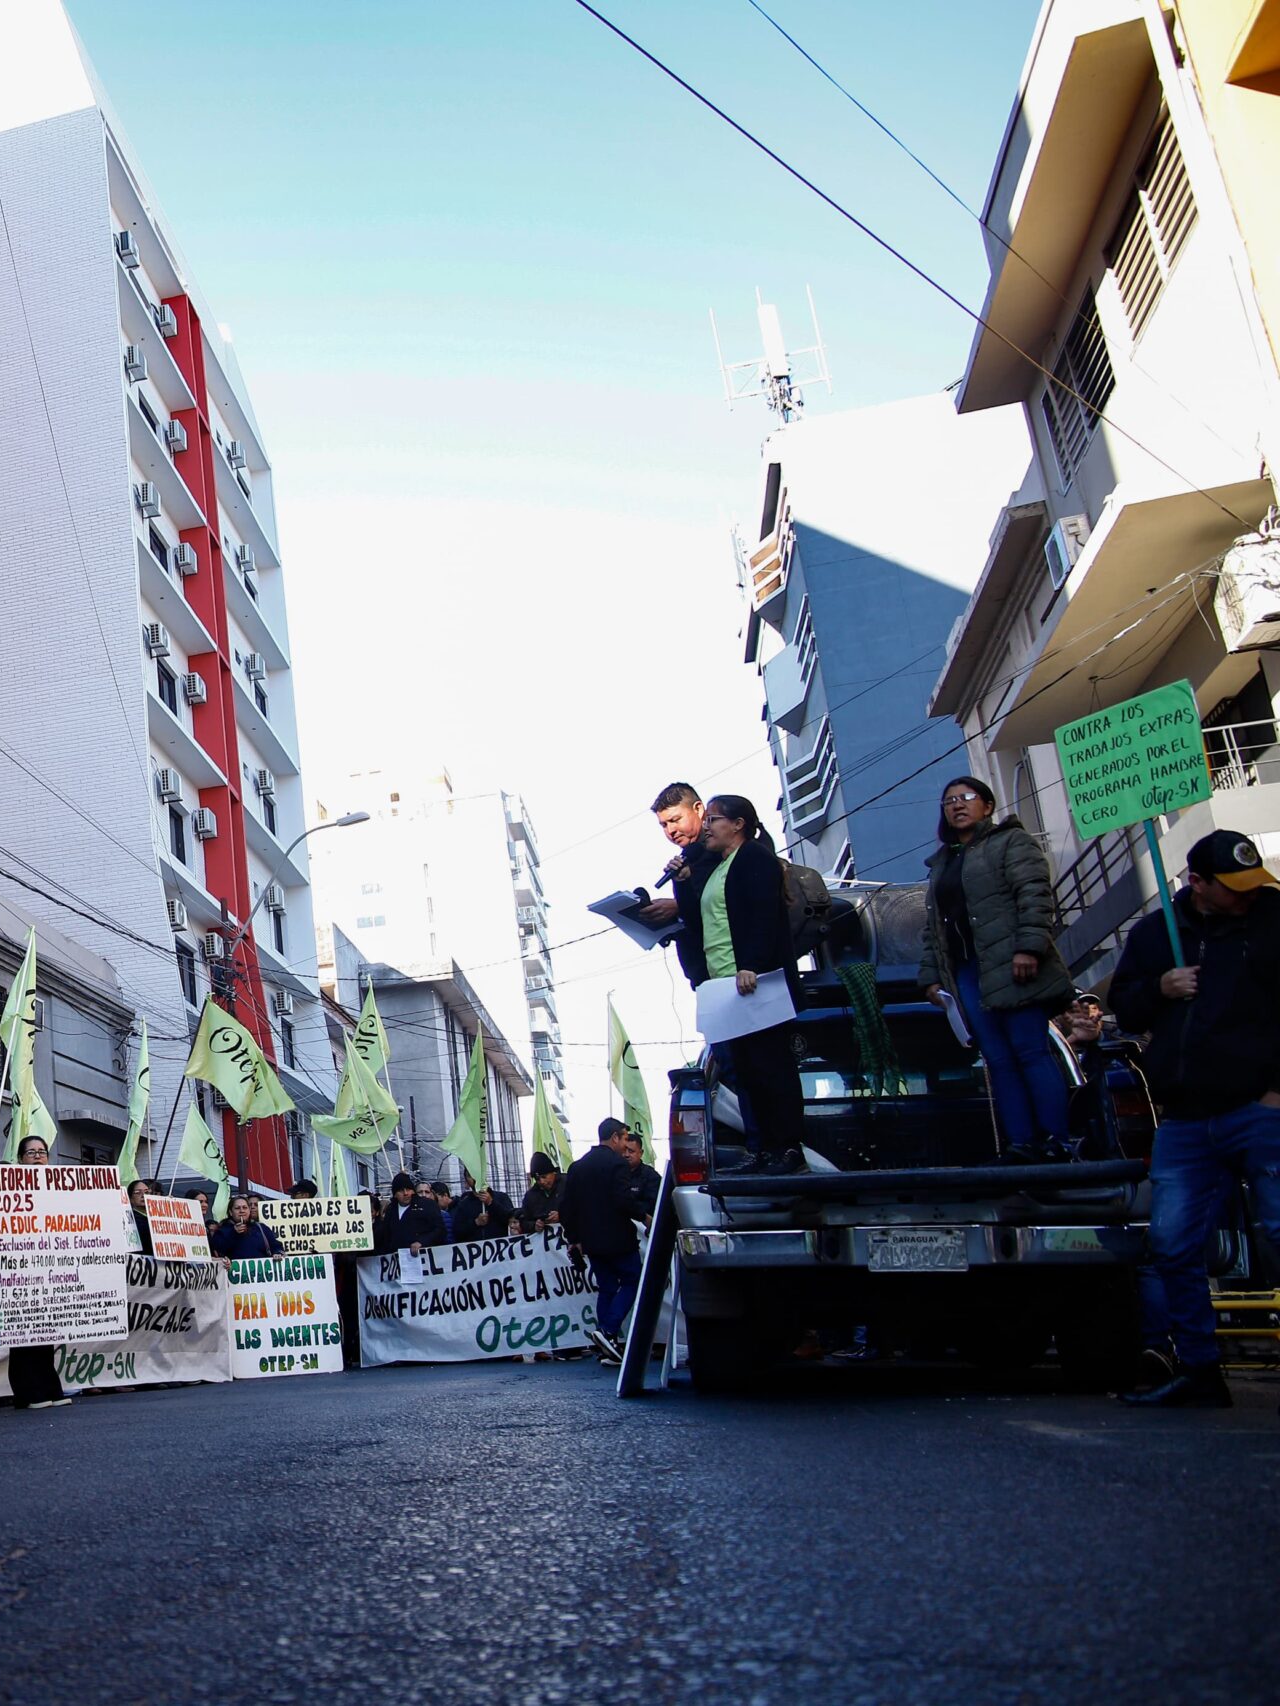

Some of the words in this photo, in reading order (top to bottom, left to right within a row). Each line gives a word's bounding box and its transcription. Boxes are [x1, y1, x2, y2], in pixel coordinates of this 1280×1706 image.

[1062, 715, 1112, 746] CONTRA
[1121, 703, 1144, 723] LOS
[1067, 732, 1133, 767] TRABAJOS
[1139, 707, 1195, 738] EXTRAS
[1069, 752, 1141, 789] GENERADOS
[1146, 743, 1168, 762] POR
[1171, 737, 1190, 754] EL
[1074, 773, 1142, 807] PROGRAMA
[1150, 752, 1205, 781] HAMBRE
[1081, 804, 1119, 825] CERO
[45, 1165, 120, 1192] PRESIDENCIAL
[261, 1203, 276, 1220] EL
[280, 1201, 323, 1220] ESTADO
[327, 1200, 342, 1216] ES
[347, 1199, 361, 1215] EL
[10, 1215, 43, 1234] EDUC.
[45, 1214, 101, 1233] PARAGUAYA
[289, 1222, 339, 1238] VIOLENTA
[346, 1221, 365, 1234] LOS
[38, 1236, 51, 1250] del
[54, 1236, 71, 1250] Sist.
[74, 1235, 111, 1249] Educativo
[892, 1235, 939, 1244] PARAGUAY
[0, 1254, 18, 1270] Más
[19, 1254, 29, 1269] de
[452, 1236, 534, 1272] APORTE
[31, 1286, 39, 1296] de
[42, 1285, 48, 1295] la
[489, 1275, 517, 1308] DE
[520, 1269, 550, 1303] LA
[233, 1293, 268, 1321] PARA
[275, 1290, 315, 1317] TODOS
[235, 1328, 261, 1350] LOS
[270, 1322, 341, 1348] DOCENTES
[476, 1304, 598, 1353] Otep-S
